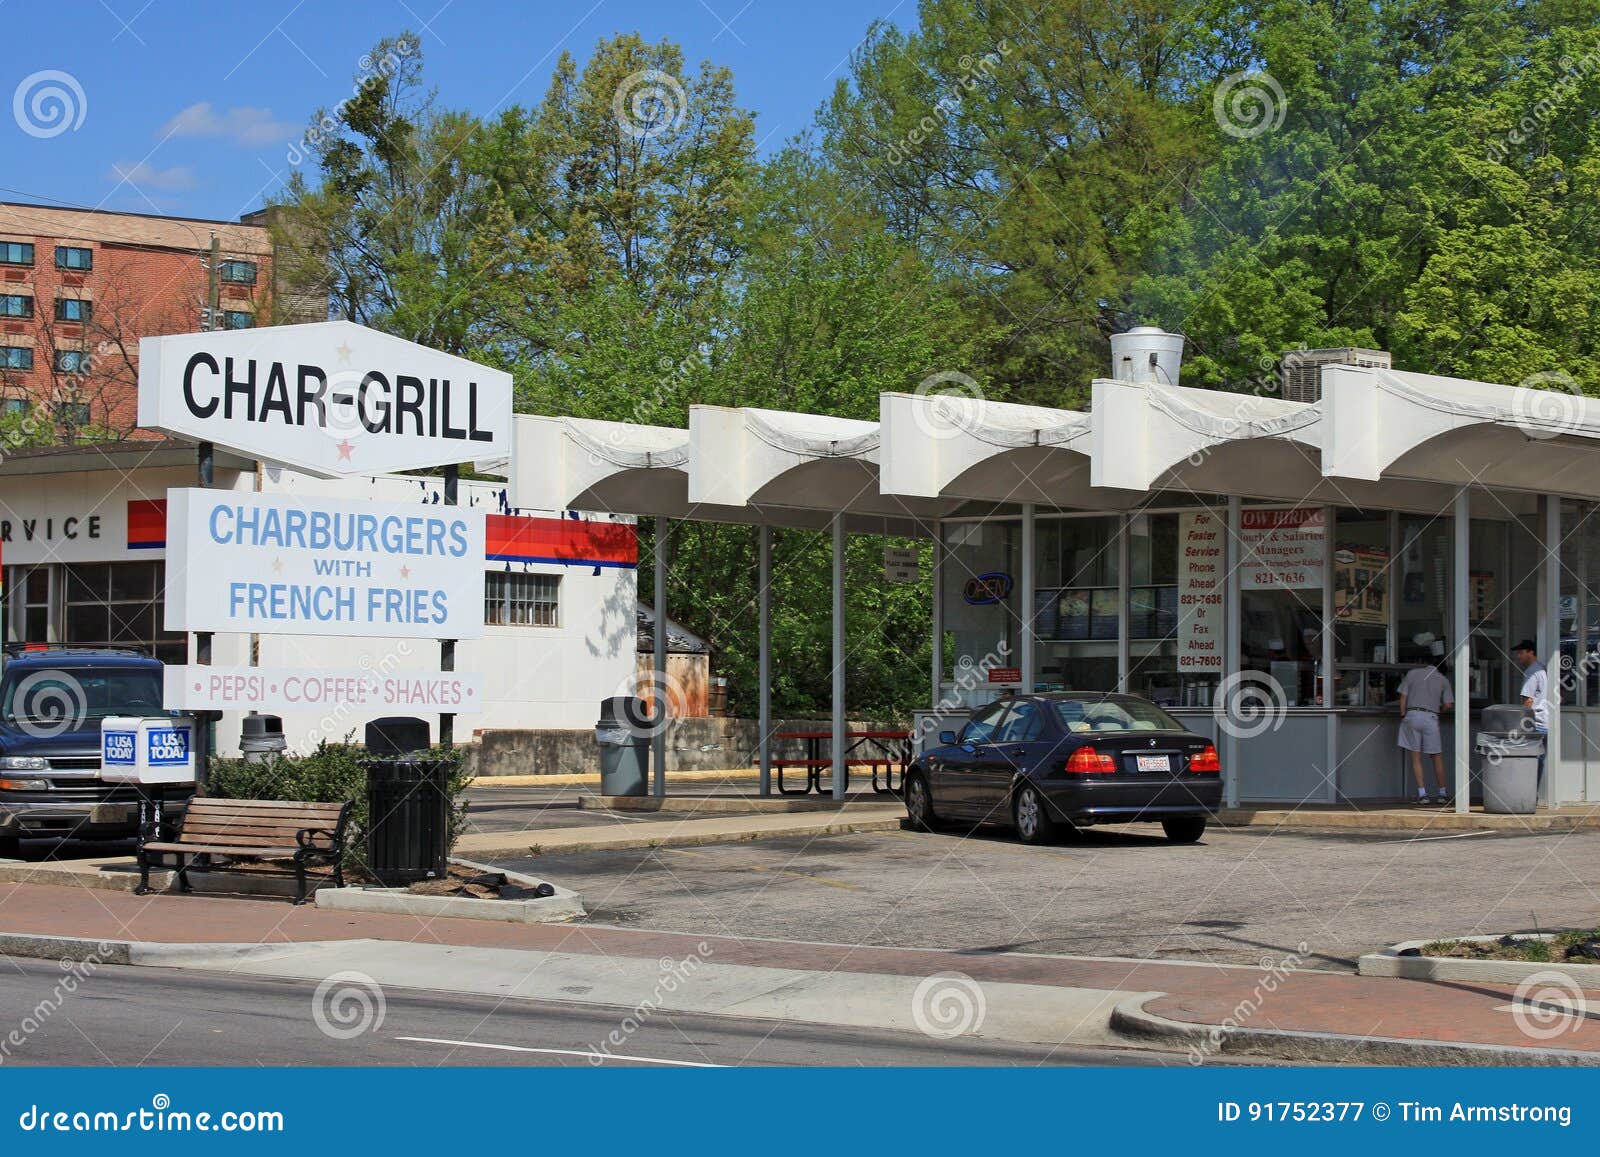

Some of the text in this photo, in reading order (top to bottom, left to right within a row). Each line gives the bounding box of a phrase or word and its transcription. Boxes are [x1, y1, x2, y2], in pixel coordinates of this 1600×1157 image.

[182, 351, 494, 443] CHAR-GRILL
[1194, 514, 1210, 524] For
[208, 504, 468, 557] CHARBURGERS
[1188, 530, 1216, 541] Faster
[1241, 532, 1265, 543] ourly
[1270, 532, 1279, 541] &
[1185, 546, 1220, 556] Service
[1255, 546, 1305, 556] Managers
[314, 560, 371, 576] WITH
[1189, 562, 1215, 572] Phone
[1188, 578, 1215, 588] Ahead
[1255, 572, 1305, 584] 821-7636
[966, 579, 1006, 598] OPEN
[229, 581, 448, 624] FRENCH FRIES
[1180, 594, 1222, 605] 821-7636
[1193, 623, 1209, 633] Fax
[1188, 639, 1215, 649] Ahead
[1180, 655, 1222, 666] 821-7603
[208, 675, 462, 706] PEPSI COFFEE SHAKES
[115, 736, 133, 747] USA
[162, 733, 185, 746] USA
[106, 747, 134, 759] TODAY
[150, 746, 187, 759] TODAY
